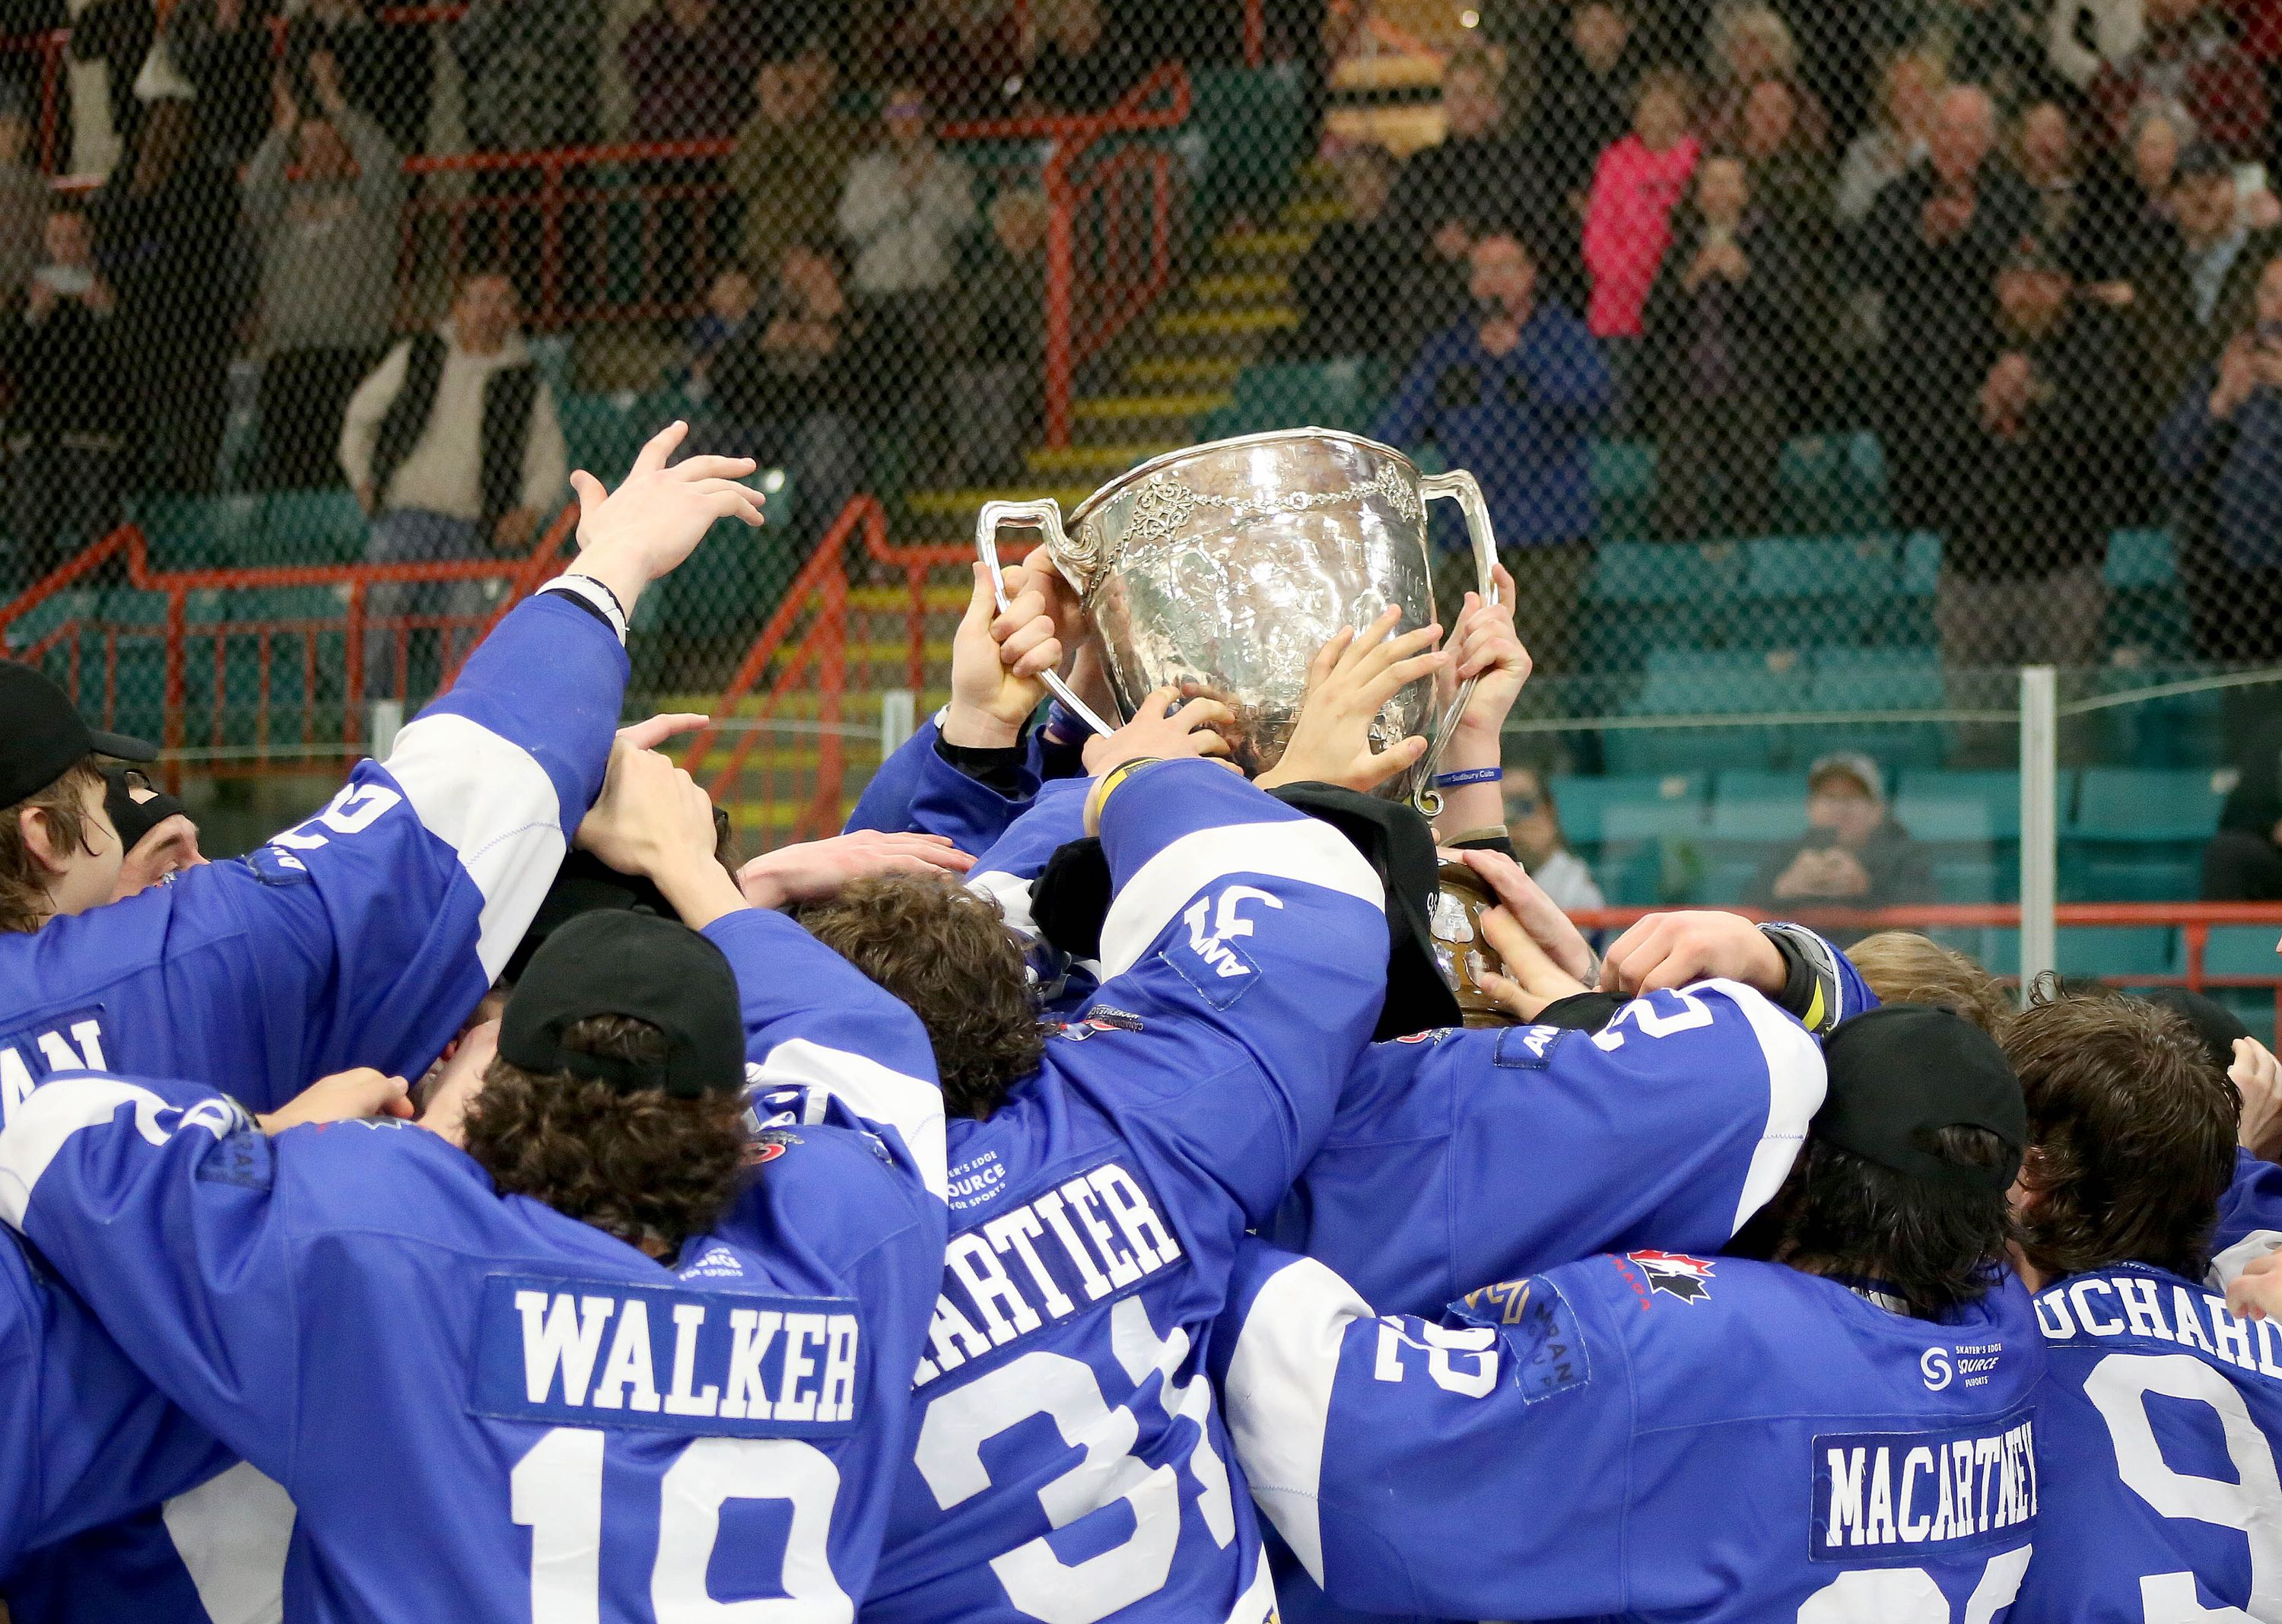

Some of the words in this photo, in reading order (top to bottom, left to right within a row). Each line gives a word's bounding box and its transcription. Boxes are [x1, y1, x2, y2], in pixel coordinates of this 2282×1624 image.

[949, 1201, 968, 1210] FOR
[969, 1181, 1006, 1207] SPORTS
[971, 1150, 998, 1168] EDGE
[913, 1163, 1181, 1387] ARTIER
[515, 1291, 859, 1422] WALKER
[1955, 1345, 1986, 1355] SKATER'S
[1987, 1343, 2002, 1353] EDGE
[2033, 1278, 2282, 1380] UCHARD
[1826, 1420, 2037, 1547] MACARTNEY
